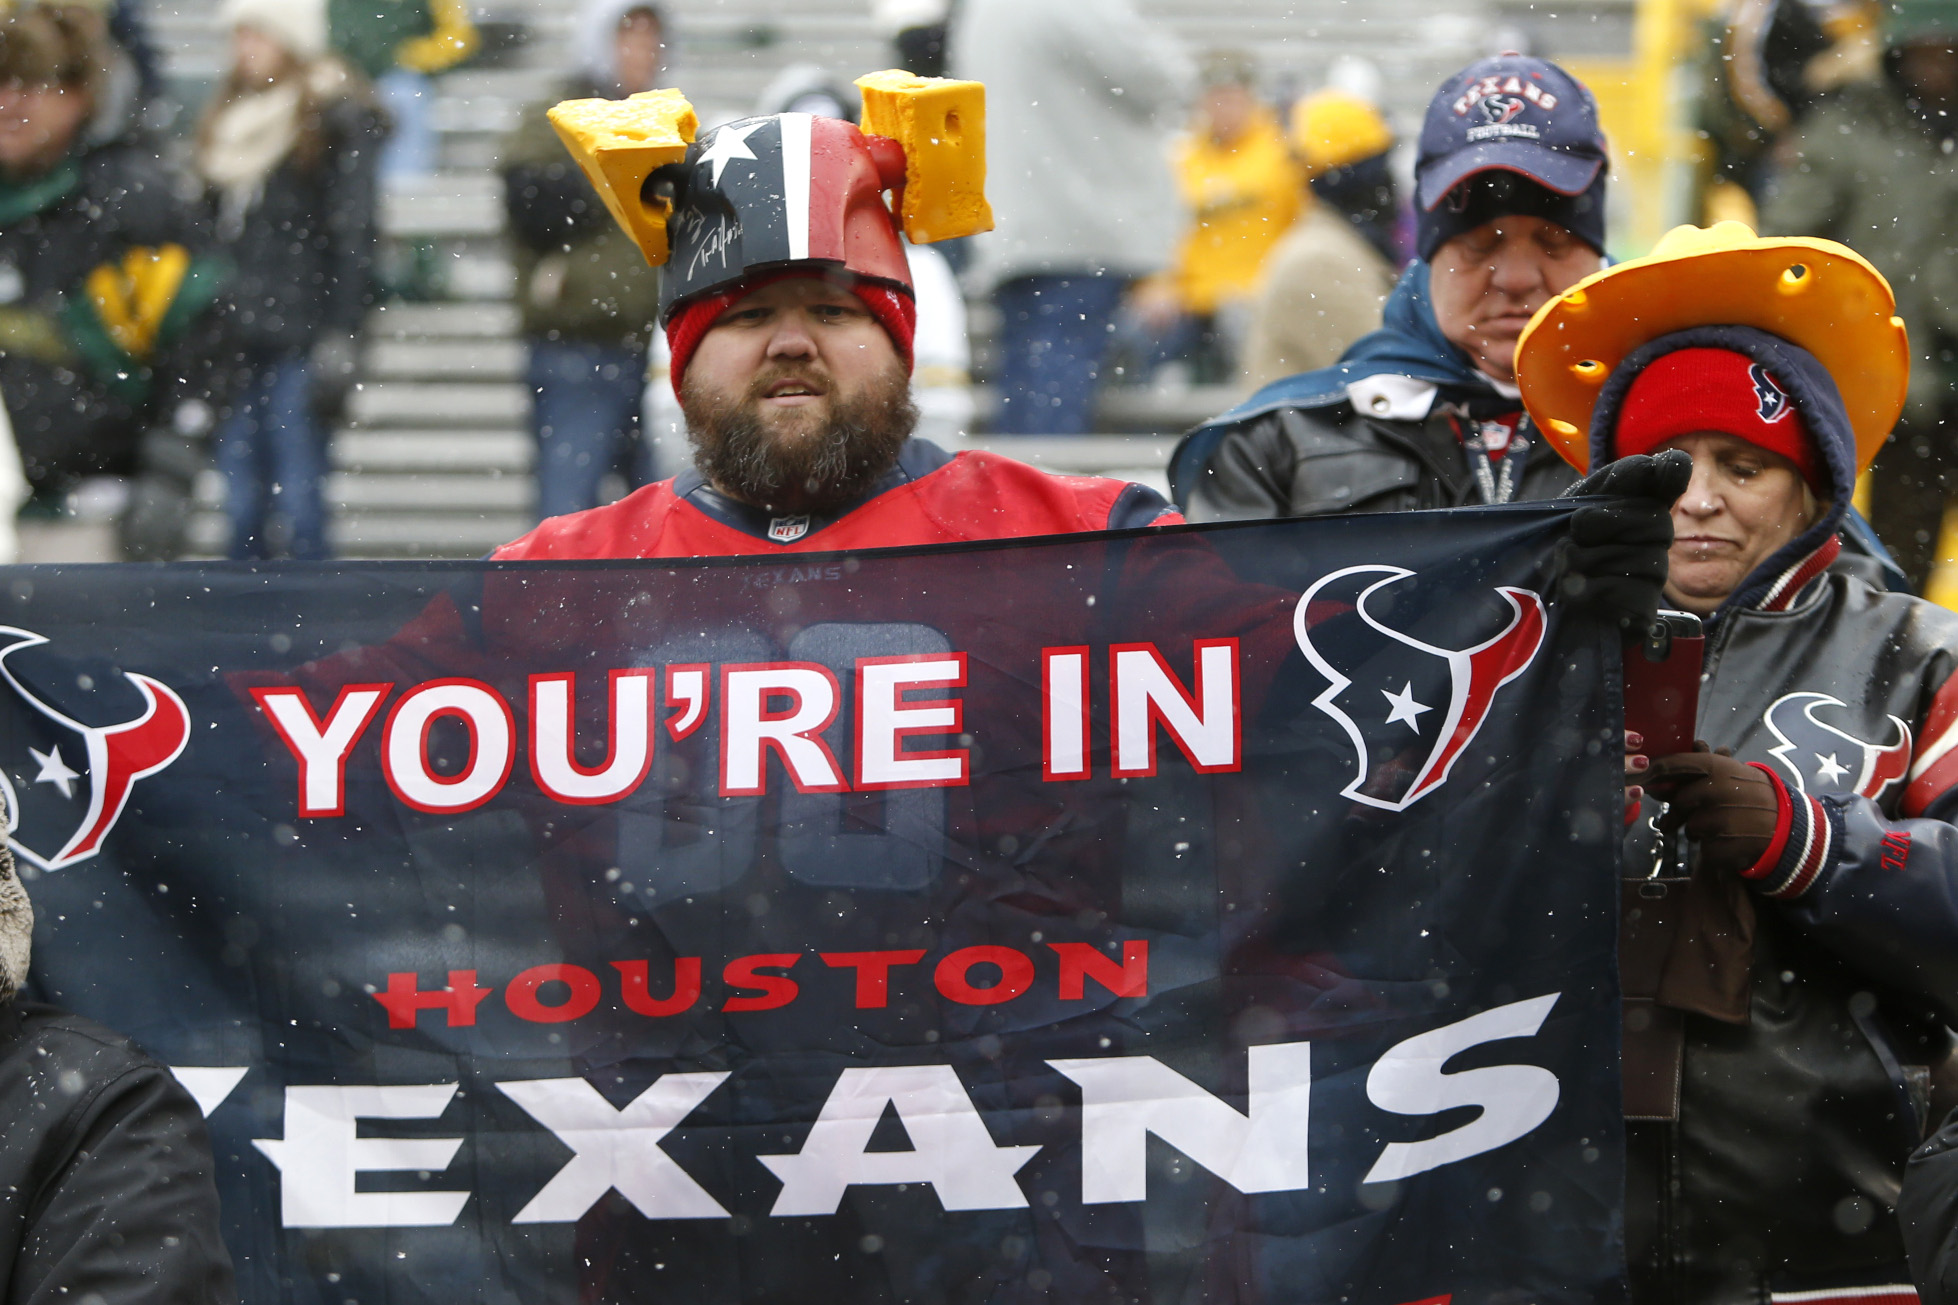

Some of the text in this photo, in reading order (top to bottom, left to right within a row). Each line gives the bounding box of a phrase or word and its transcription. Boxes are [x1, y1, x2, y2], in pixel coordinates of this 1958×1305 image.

[1453, 75, 1558, 116] TEXANS
[1466, 123, 1540, 142] FOOTBALL
[775, 525, 801, 537] NFL
[741, 566, 842, 590] TEXANS
[248, 636, 1242, 818] YOU'RE IN
[1880, 829, 1912, 871] NFL
[371, 940, 1148, 1029] HOUSTON
[168, 992, 1560, 1227] EXANS
